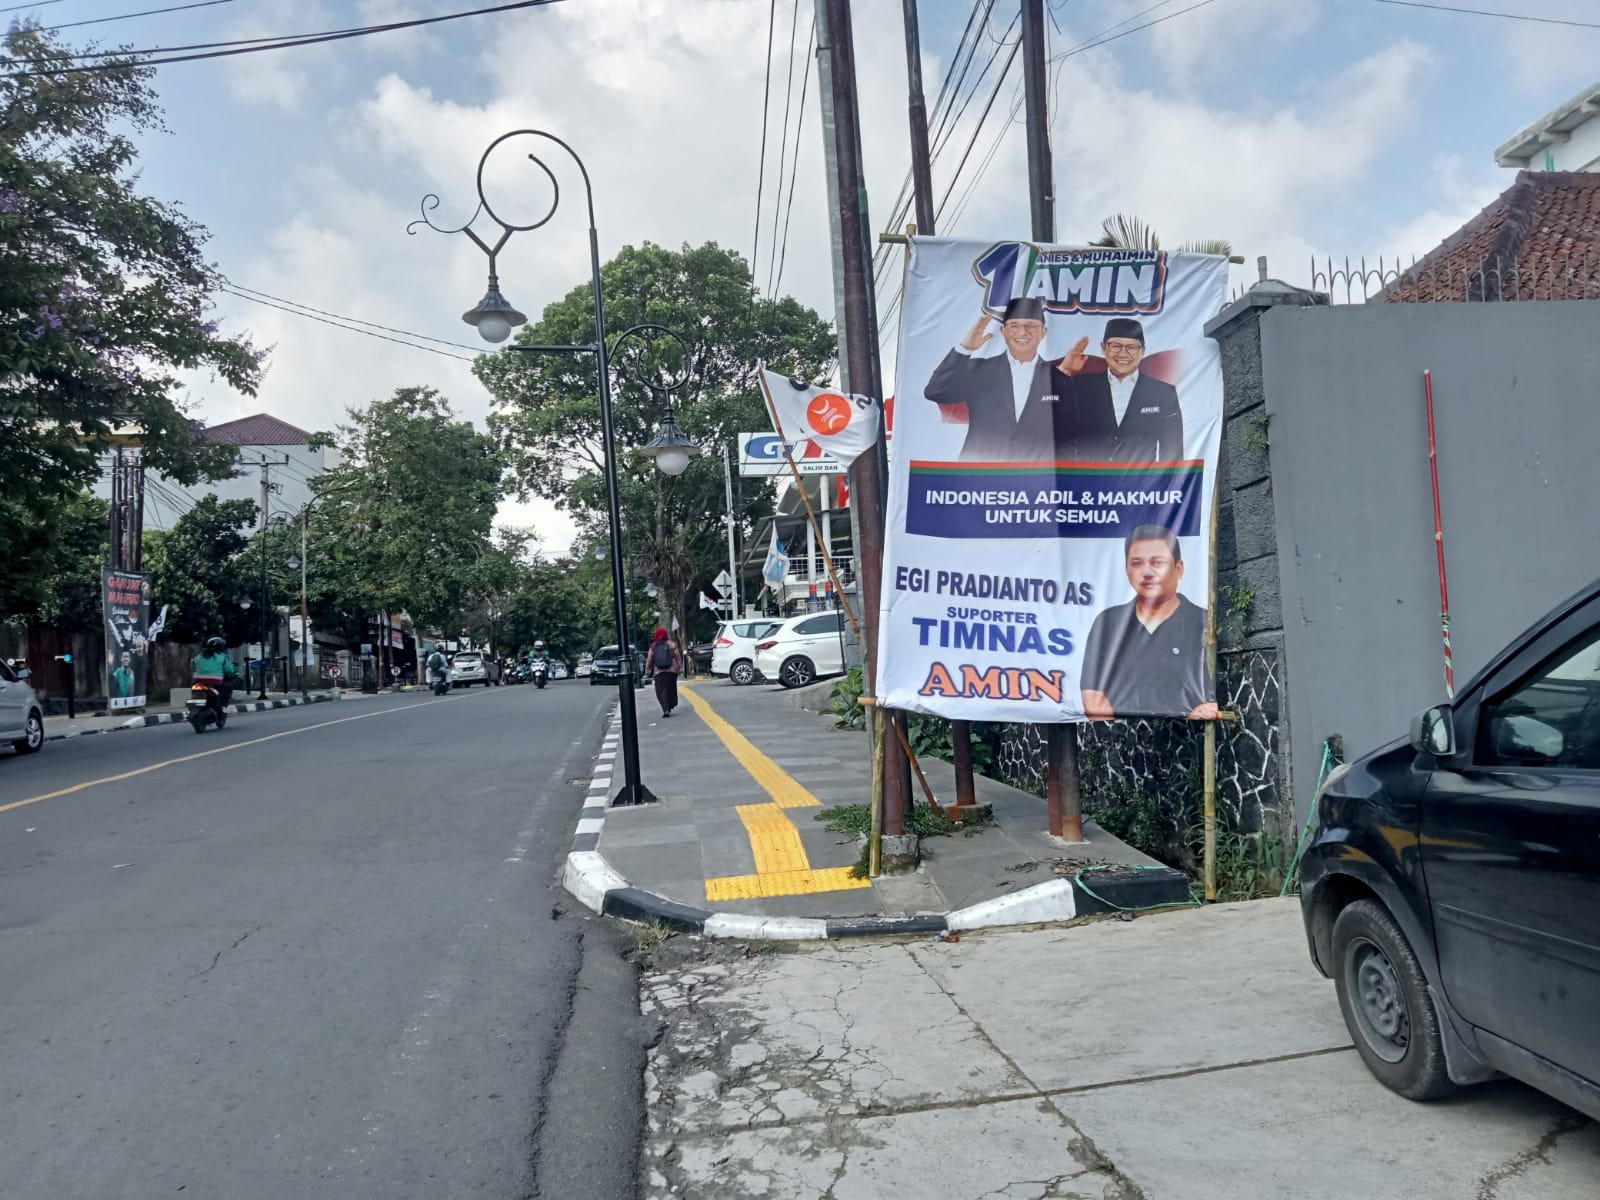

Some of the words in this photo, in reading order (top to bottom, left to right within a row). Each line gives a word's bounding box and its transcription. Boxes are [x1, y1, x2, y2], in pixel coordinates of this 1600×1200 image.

[1036, 253, 1069, 264] ANIES
[1071, 253, 1080, 262] &
[1083, 250, 1157, 262] MUHAIMIN
[1026, 264, 1156, 304] AMIN
[926, 490, 1029, 505] INDONESIA
[1035, 490, 1078, 505] ADIL
[1081, 490, 1095, 505] &
[1098, 490, 1182, 505] MAKMUR
[985, 509, 1052, 524] UNTUK
[1055, 508, 1120, 524] SEMUA
[895, 566, 930, 593] EGI
[937, 571, 1057, 603] PRADIANTO
[1063, 582, 1094, 606] AS
[946, 606, 1038, 625] SUPORTER
[912, 617, 1073, 656] TIMNAS
[919, 662, 1066, 703] AMIN
